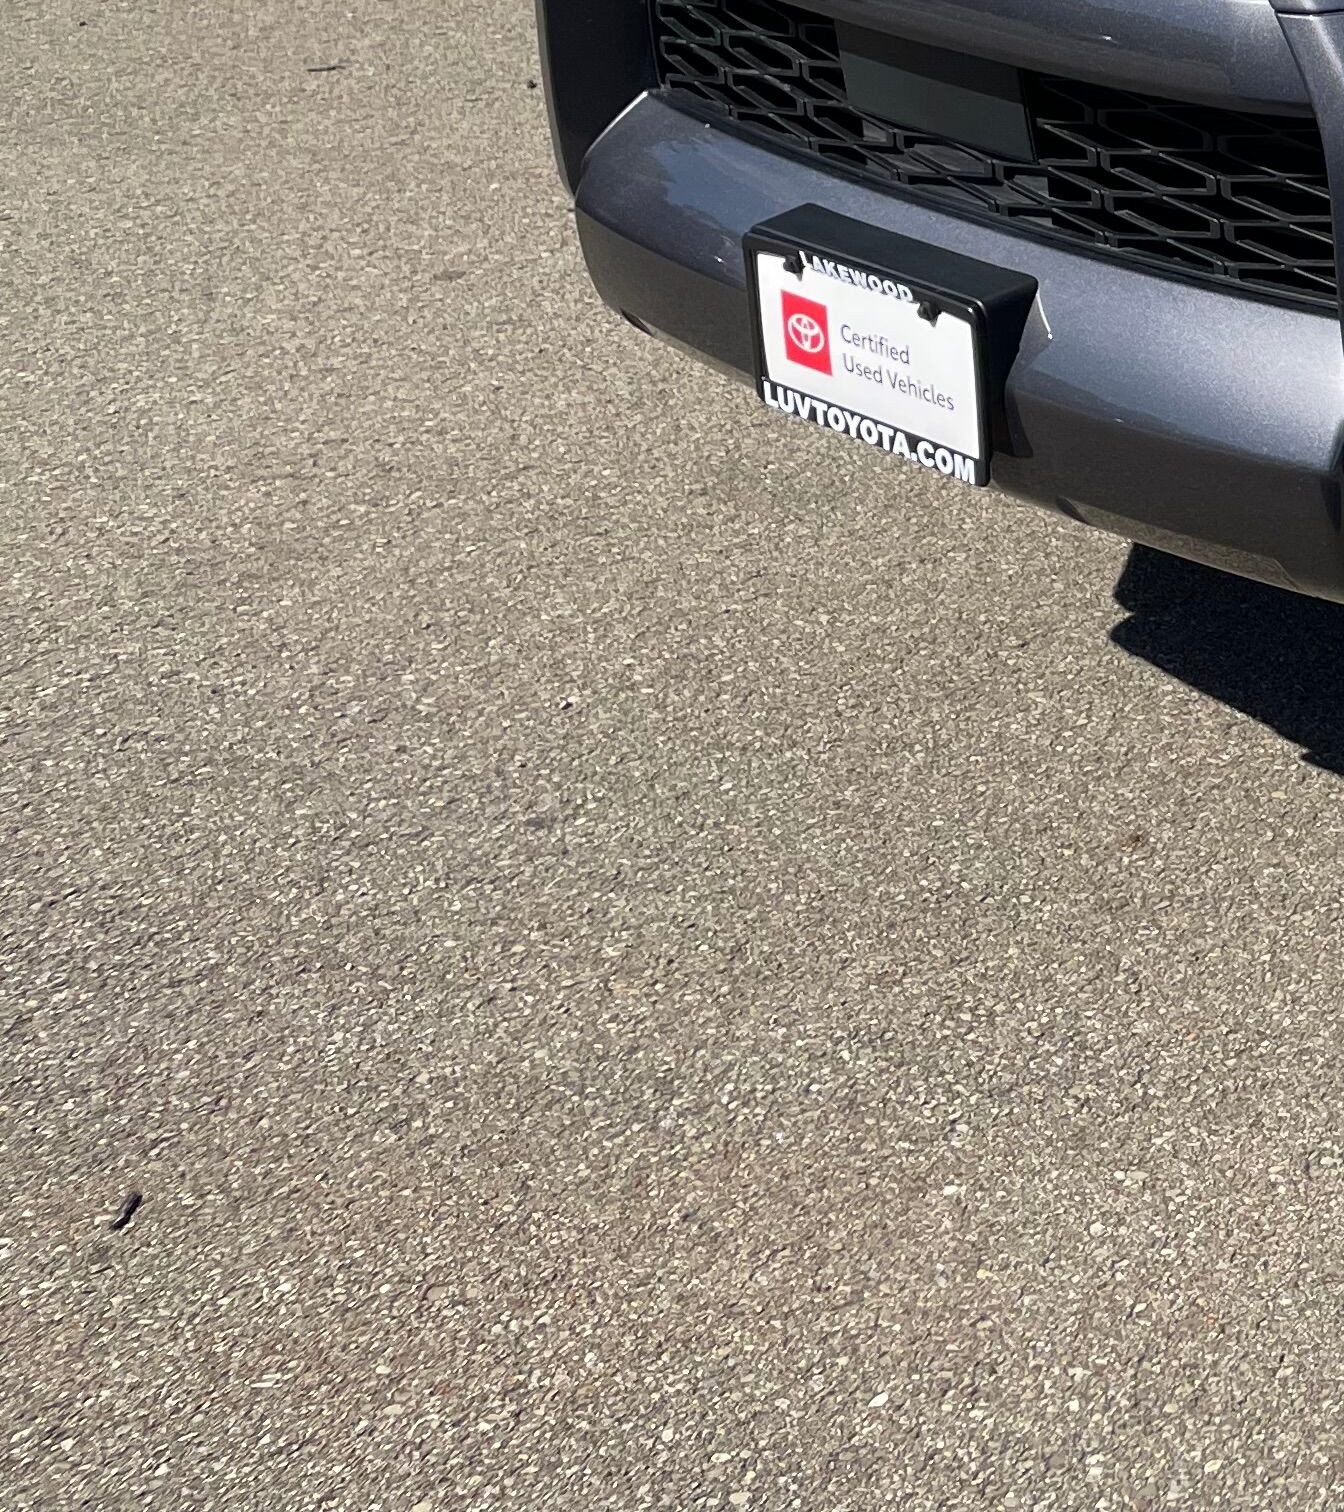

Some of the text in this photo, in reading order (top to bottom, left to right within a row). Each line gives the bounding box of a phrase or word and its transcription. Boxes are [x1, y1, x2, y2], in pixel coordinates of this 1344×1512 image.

[799, 251, 912, 302] LAKEWOOD
[840, 324, 910, 365] Certified
[843, 354, 954, 411] Used Vehicles
[763, 381, 976, 484] LUVTOYOTA.COM
